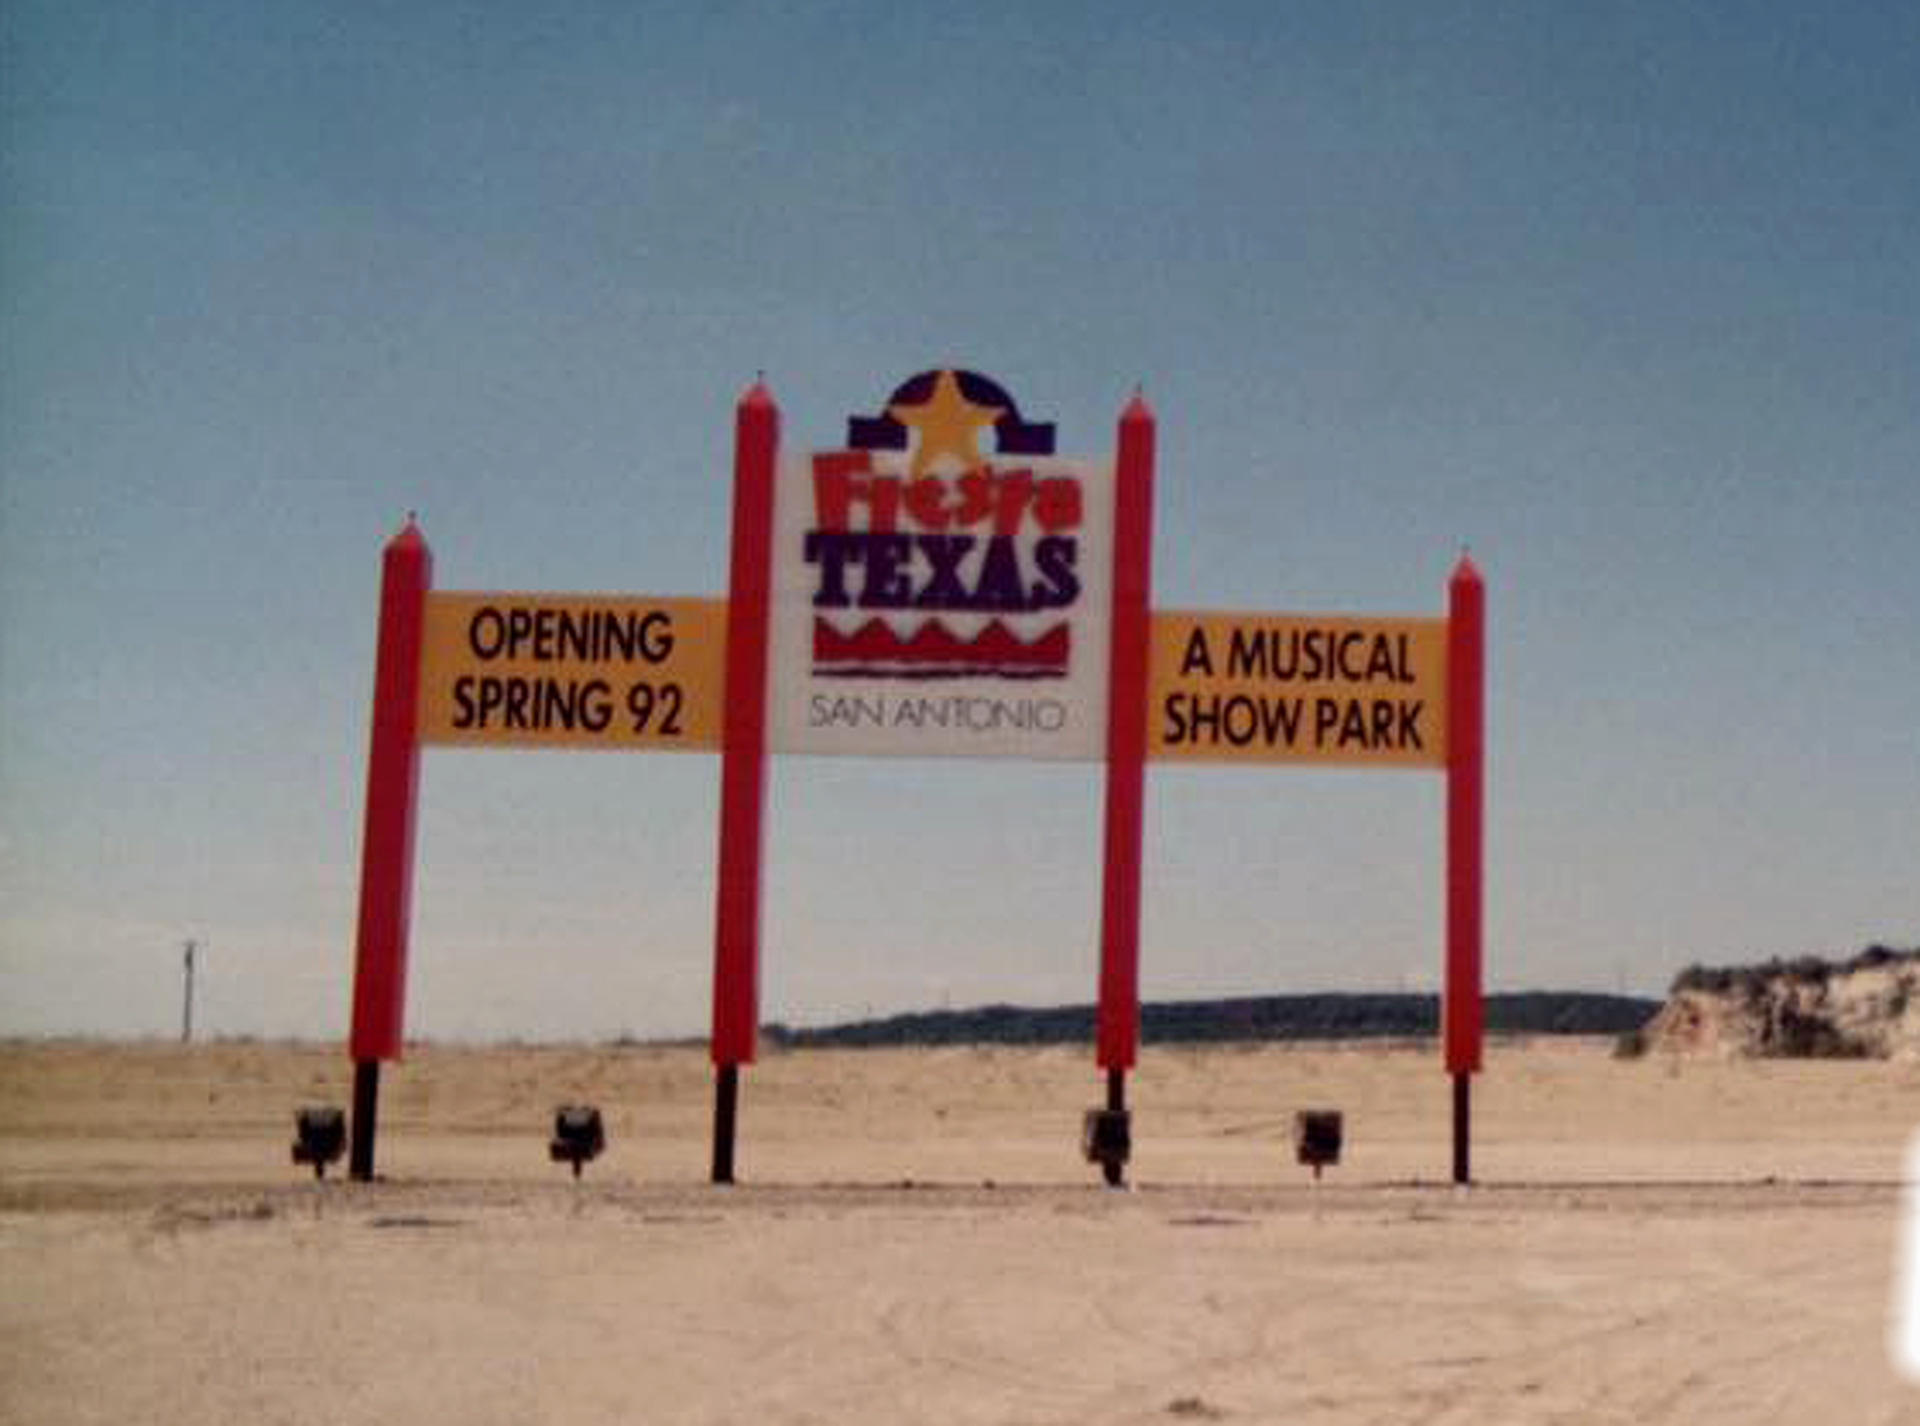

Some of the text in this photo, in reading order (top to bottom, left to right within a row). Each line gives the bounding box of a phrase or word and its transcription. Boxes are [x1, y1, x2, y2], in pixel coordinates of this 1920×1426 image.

[804, 531, 1082, 613] TEXAS
[469, 607, 674, 663] OPENING
[1180, 625, 1416, 683] A MUSICAL
[452, 675, 682, 735] SPRING 92
[811, 694, 1067, 733] SAN ANTONIO
[1163, 692, 1424, 749] SHOW PARK
